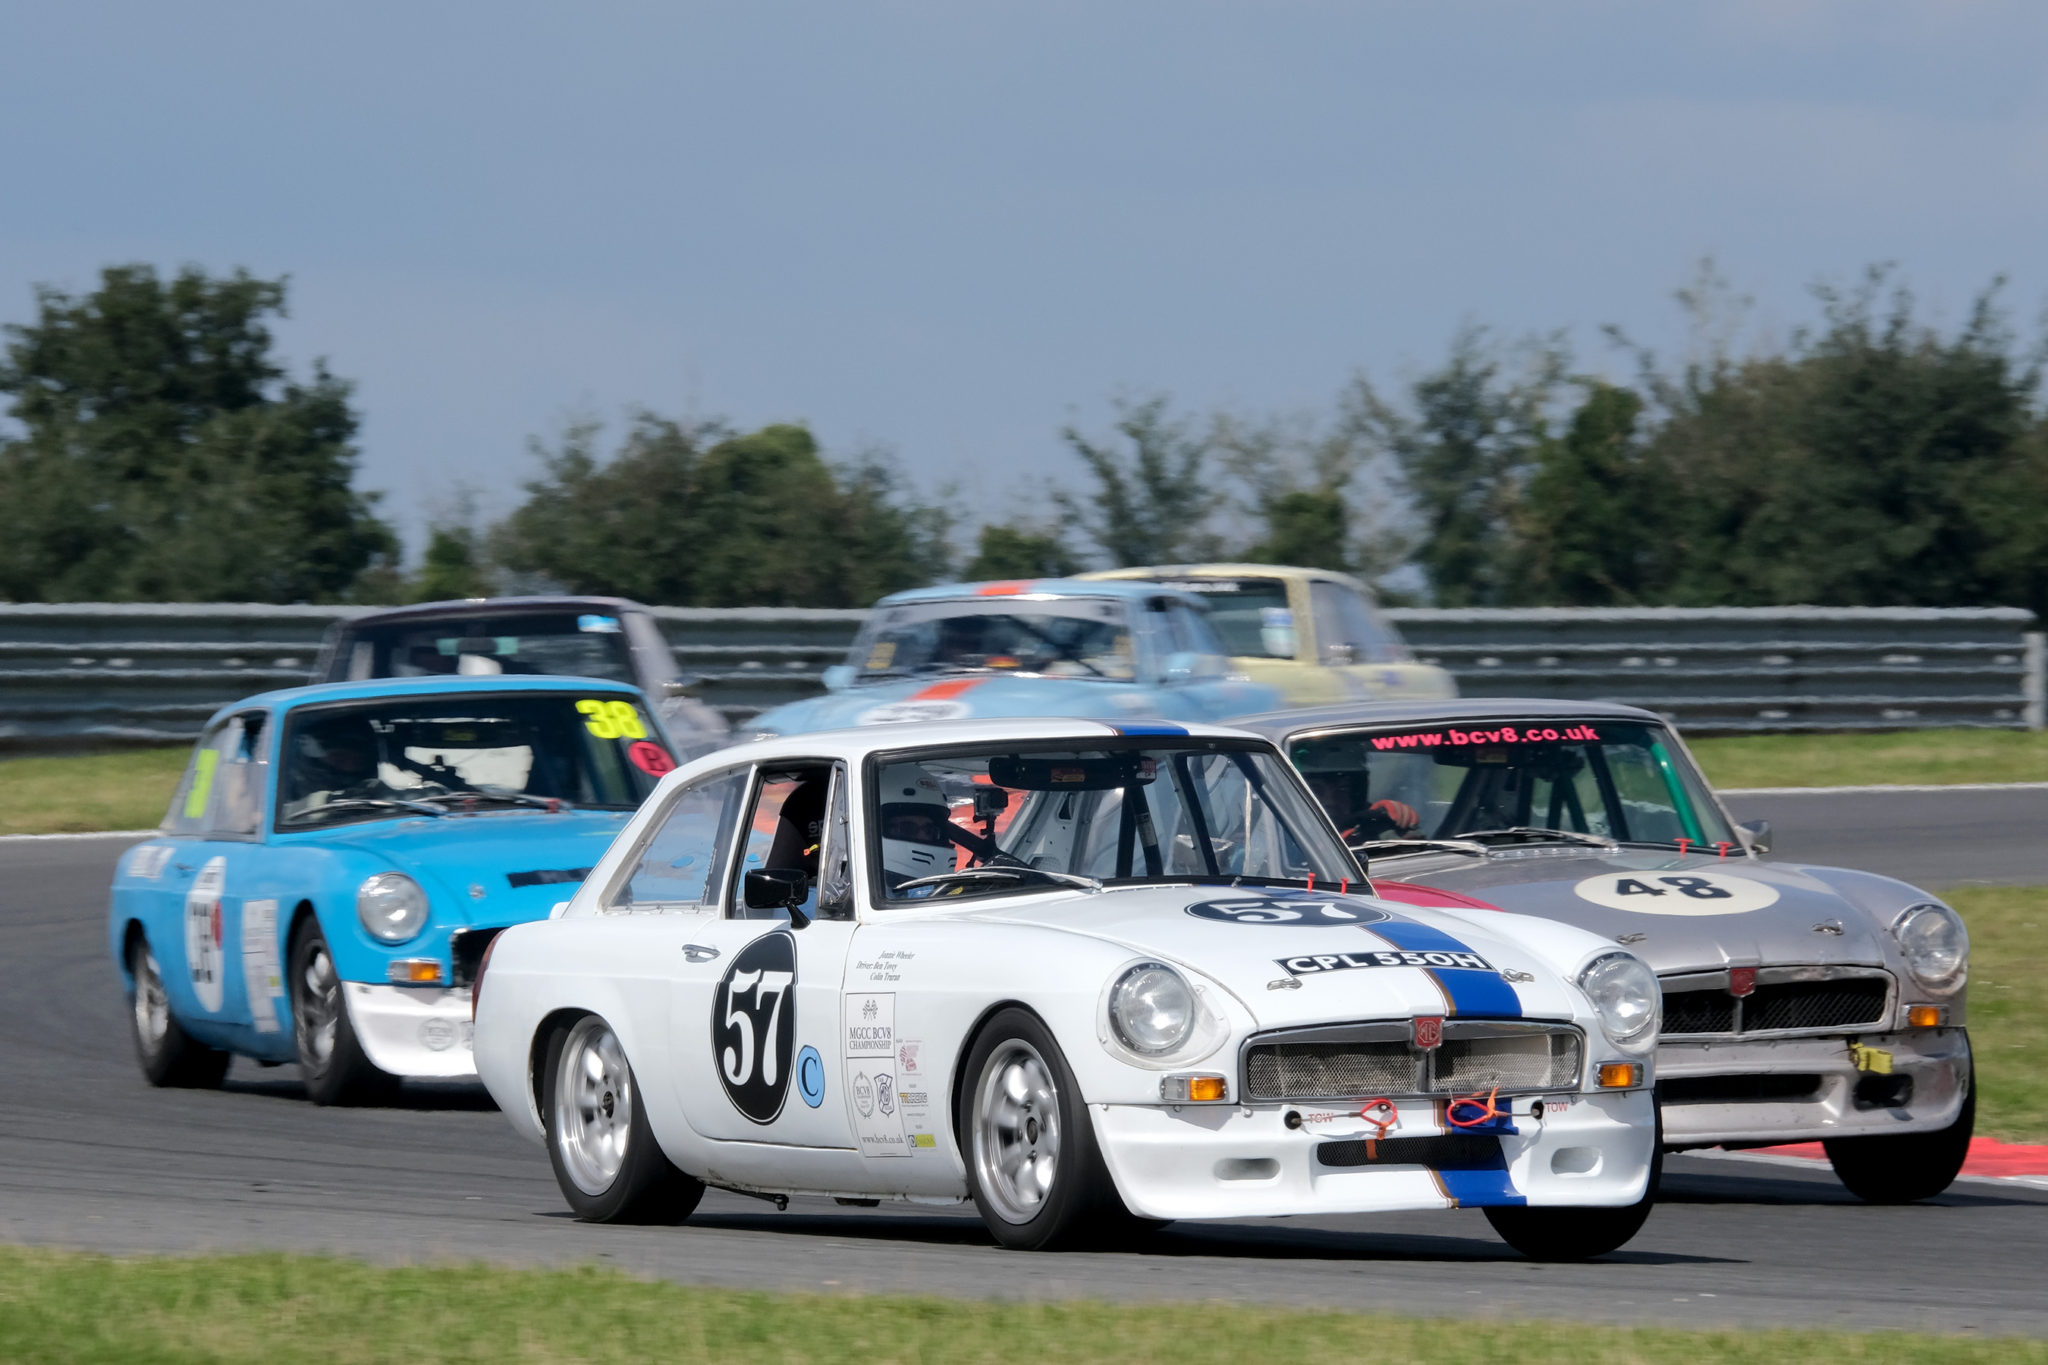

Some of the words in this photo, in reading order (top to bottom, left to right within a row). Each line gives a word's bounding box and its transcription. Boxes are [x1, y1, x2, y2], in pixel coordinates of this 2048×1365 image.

[575, 699, 648, 739] 38
[1371, 725, 1600, 750] www.bcv8.co.uk
[1616, 876, 1734, 899] 48
[1208, 901, 1358, 922] 57
[1286, 954, 1371, 974] CPL
[1378, 953, 1485, 970] 550H
[723, 968, 794, 1086] 57
[849, 1026, 872, 1040] MGCC
[872, 1026, 892, 1040] BCV8
[1418, 1021, 1440, 1043] MG
[849, 1040, 892, 1050] CHAMPIONSHIP
[801, 1056, 818, 1097] C
[1308, 1113, 1334, 1123] TOW
[1545, 1102, 1569, 1113] TOW
